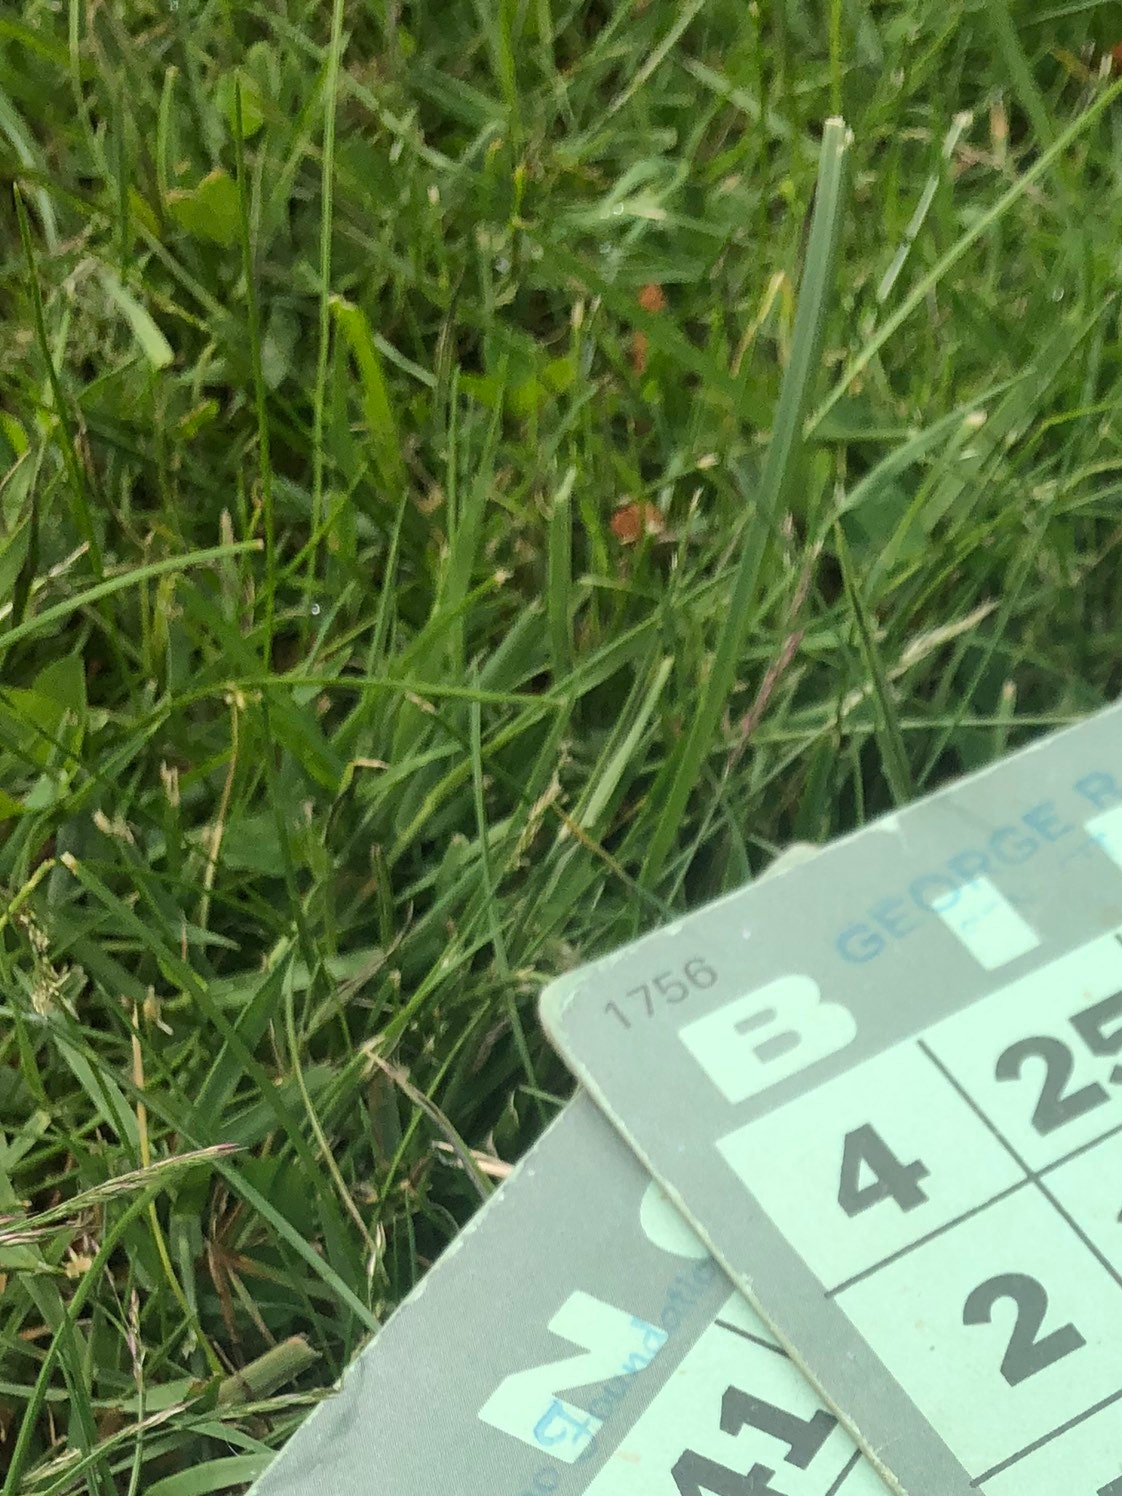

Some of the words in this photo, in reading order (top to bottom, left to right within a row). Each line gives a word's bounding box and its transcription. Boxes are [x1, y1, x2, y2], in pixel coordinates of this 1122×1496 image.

[835, 801, 1075, 963] GEORGE
[604, 956, 719, 1030] 1756
[838, 1123, 929, 1217] 4
[963, 1273, 1086, 1387] 2
